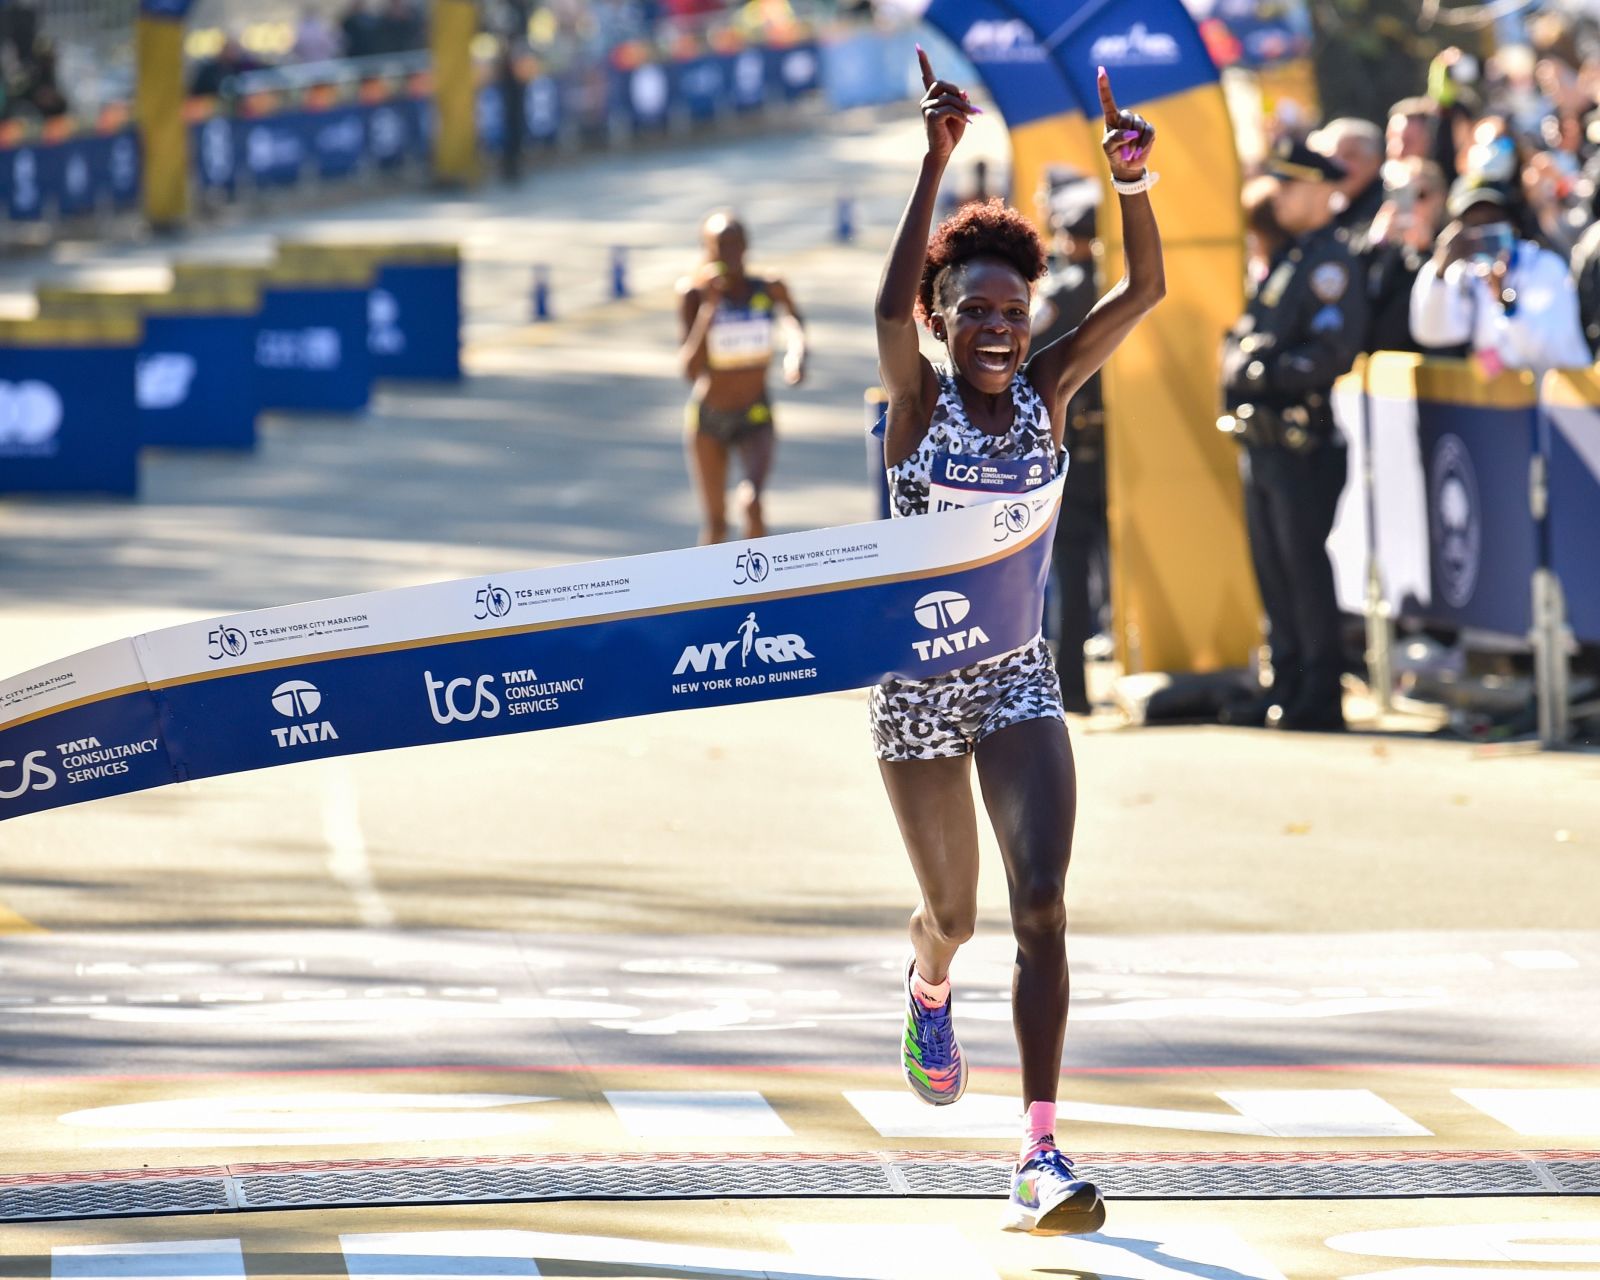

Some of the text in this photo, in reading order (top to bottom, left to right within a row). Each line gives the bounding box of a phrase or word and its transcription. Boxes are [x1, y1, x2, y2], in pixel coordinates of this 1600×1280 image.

[945, 458, 979, 483] tcs
[1025, 477, 1043, 486] TATA
[993, 503, 1031, 542] 50
[733, 548, 769, 585] 50
[772, 543, 878, 564] TCS NEW YORK CITY MARATHON
[473, 583, 512, 620] 50
[515, 578, 630, 599] TCS NEW YORK CITY MARATHON
[249, 614, 368, 638] TCS NEW YORK CITY MARATHON
[208, 624, 248, 660] 50
[911, 626, 990, 662] TATA
[5, 688, 24, 700] CITY
[26, 672, 74, 692] MARATHON
[502, 669, 538, 685] TATA
[505, 678, 584, 700] CONSULTANCY
[672, 667, 818, 694] NEW YORK ROAD RUNNERS
[423, 670, 501, 725] tcs
[508, 697, 559, 716] SERVICES
[56, 736, 101, 755] TATA
[270, 720, 339, 748] TATA
[62, 738, 158, 769] CONSULTANCY
[66, 760, 130, 784] SERVICES
